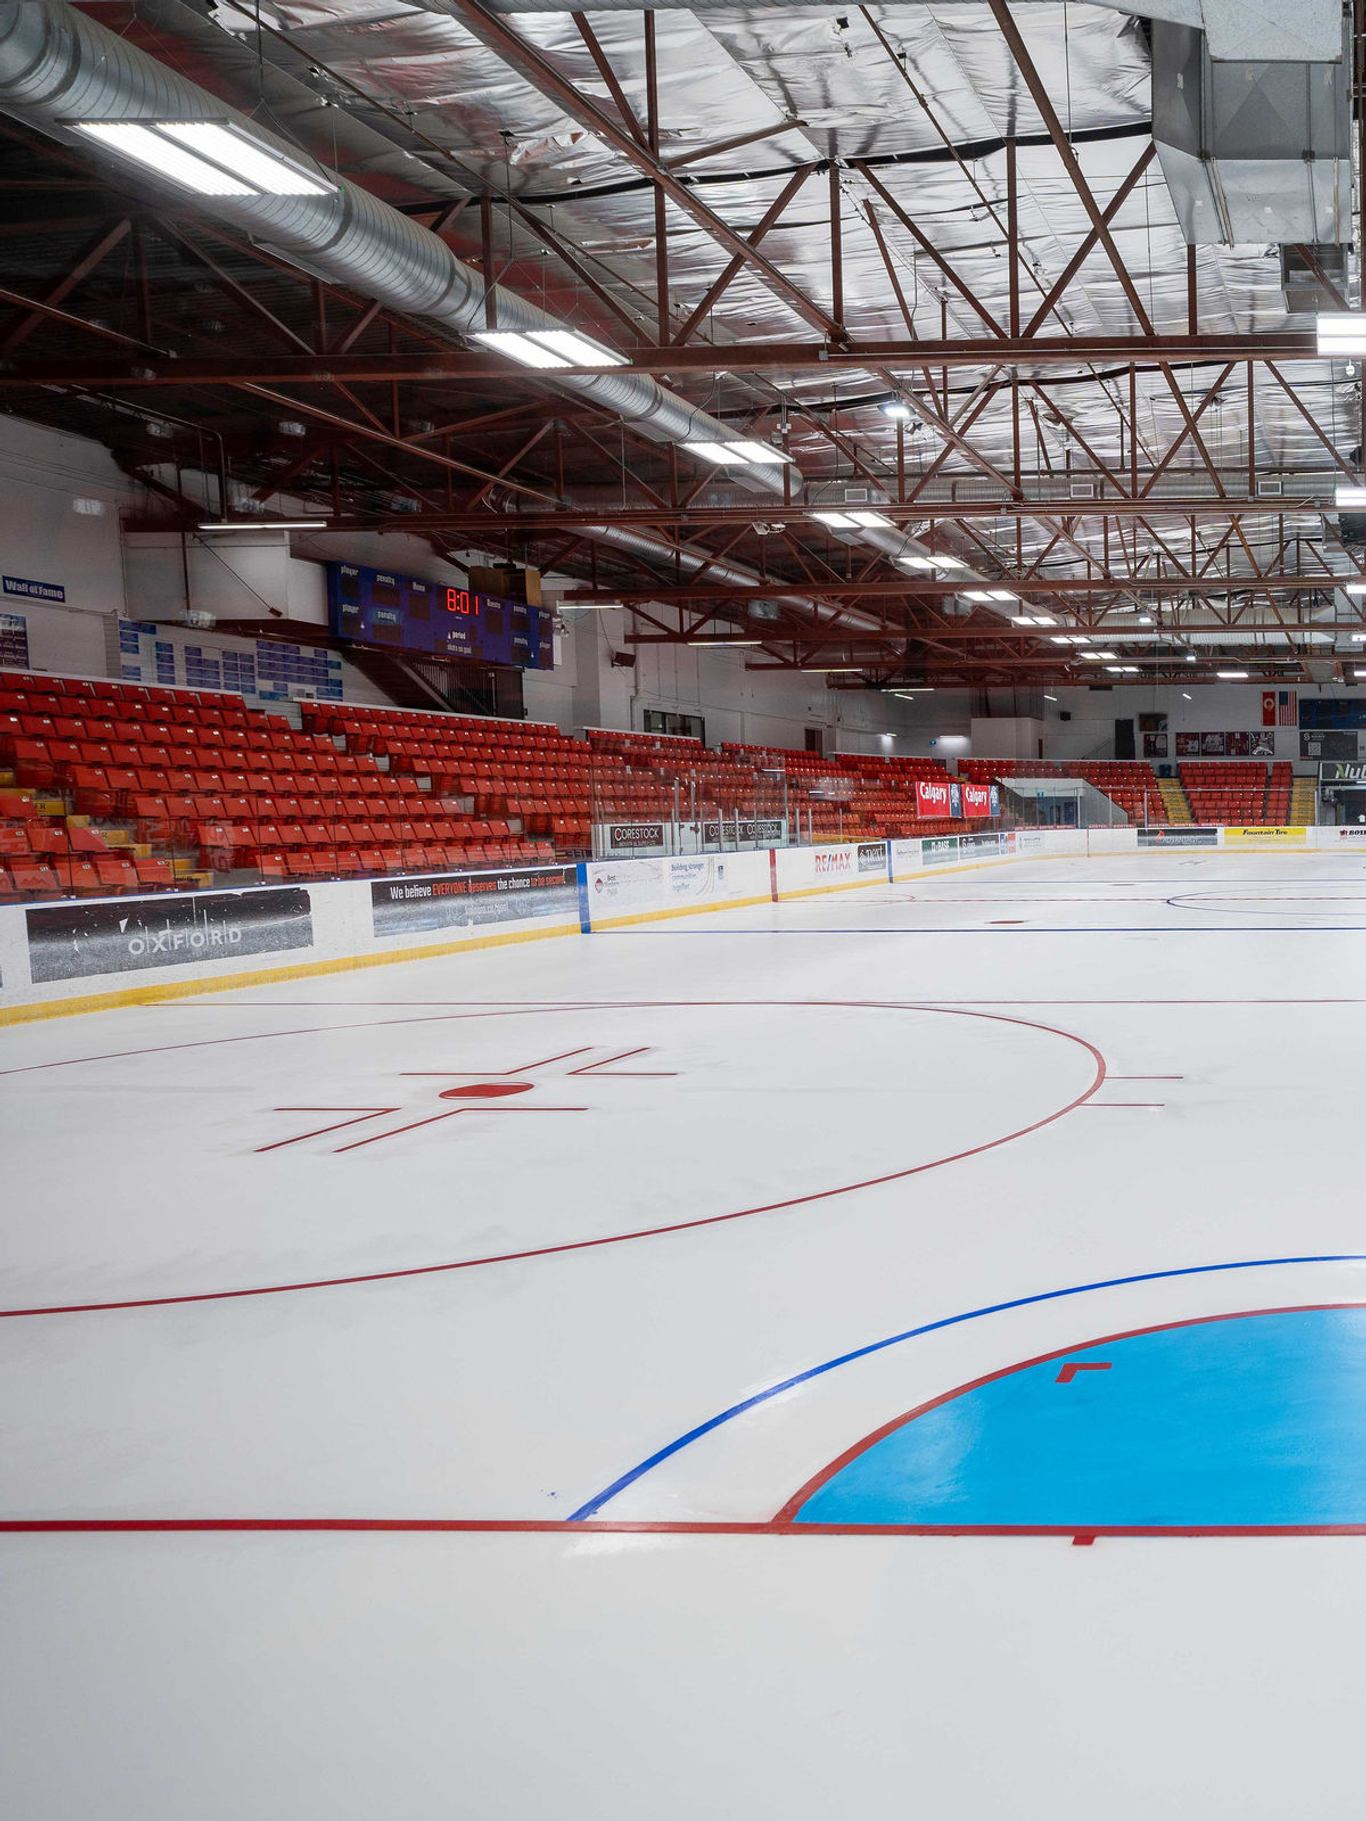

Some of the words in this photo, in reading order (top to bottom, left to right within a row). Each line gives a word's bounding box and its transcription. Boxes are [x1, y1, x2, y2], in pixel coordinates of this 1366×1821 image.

[6, 580, 28, 592] Wall
[29, 584, 38, 594] of
[39, 586, 64, 599] Fame
[376, 574, 395, 586] penalty
[447, 588, 479, 616] 8:01
[919, 782, 947, 805] Calgary
[965, 786, 988, 806] Calgary
[614, 827, 659, 841] CORESTOCK
[815, 853, 850, 873] RE/MAX
[390, 886, 404, 900] We
[404, 883, 432, 898] believe
[432, 881, 467, 896] EVERYONE
[497, 878, 508, 891] the
[508, 876, 531, 890] chance
[128, 927, 242, 956] OXFORD
